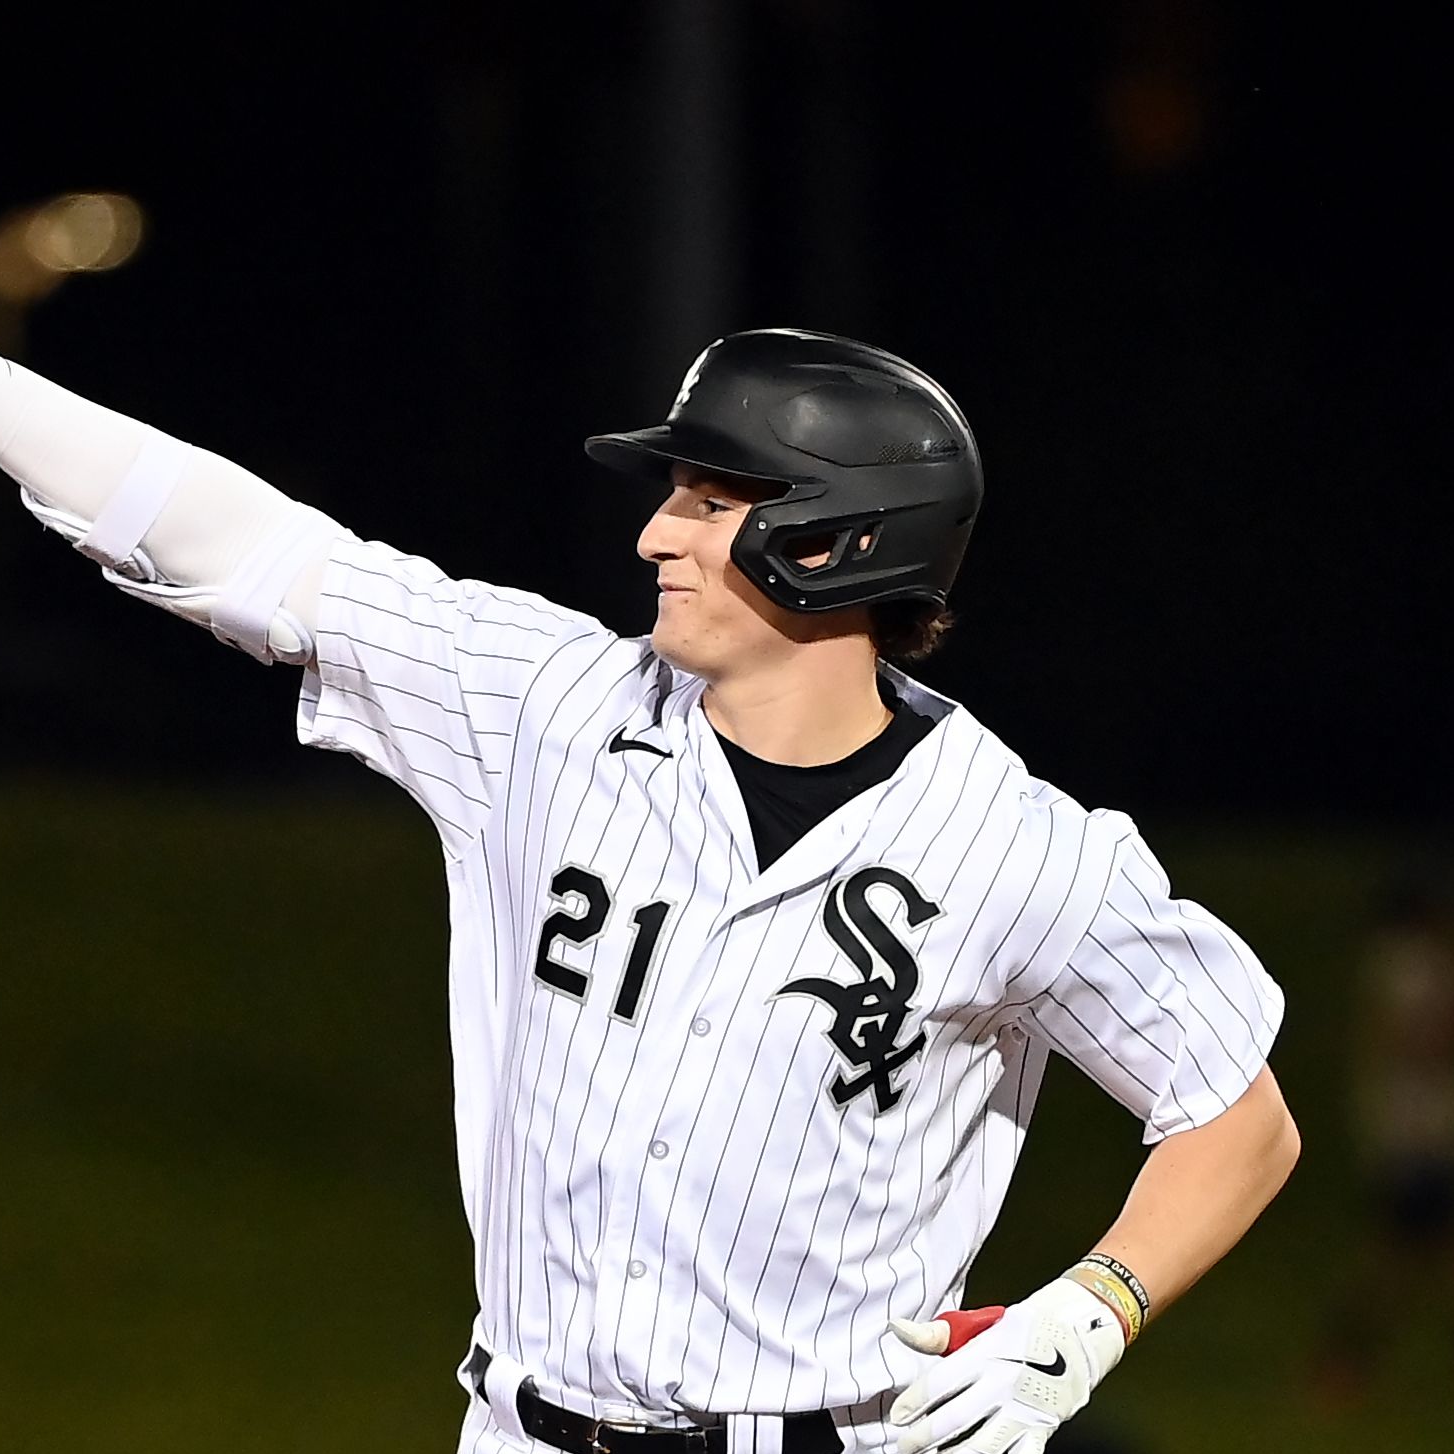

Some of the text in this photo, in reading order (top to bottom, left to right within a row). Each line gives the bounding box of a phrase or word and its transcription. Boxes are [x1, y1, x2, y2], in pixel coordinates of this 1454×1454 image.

[533, 861, 677, 1027] 21
[1111, 1261, 1131, 1280] DAY
[1128, 1278, 1149, 1308] EVERY
